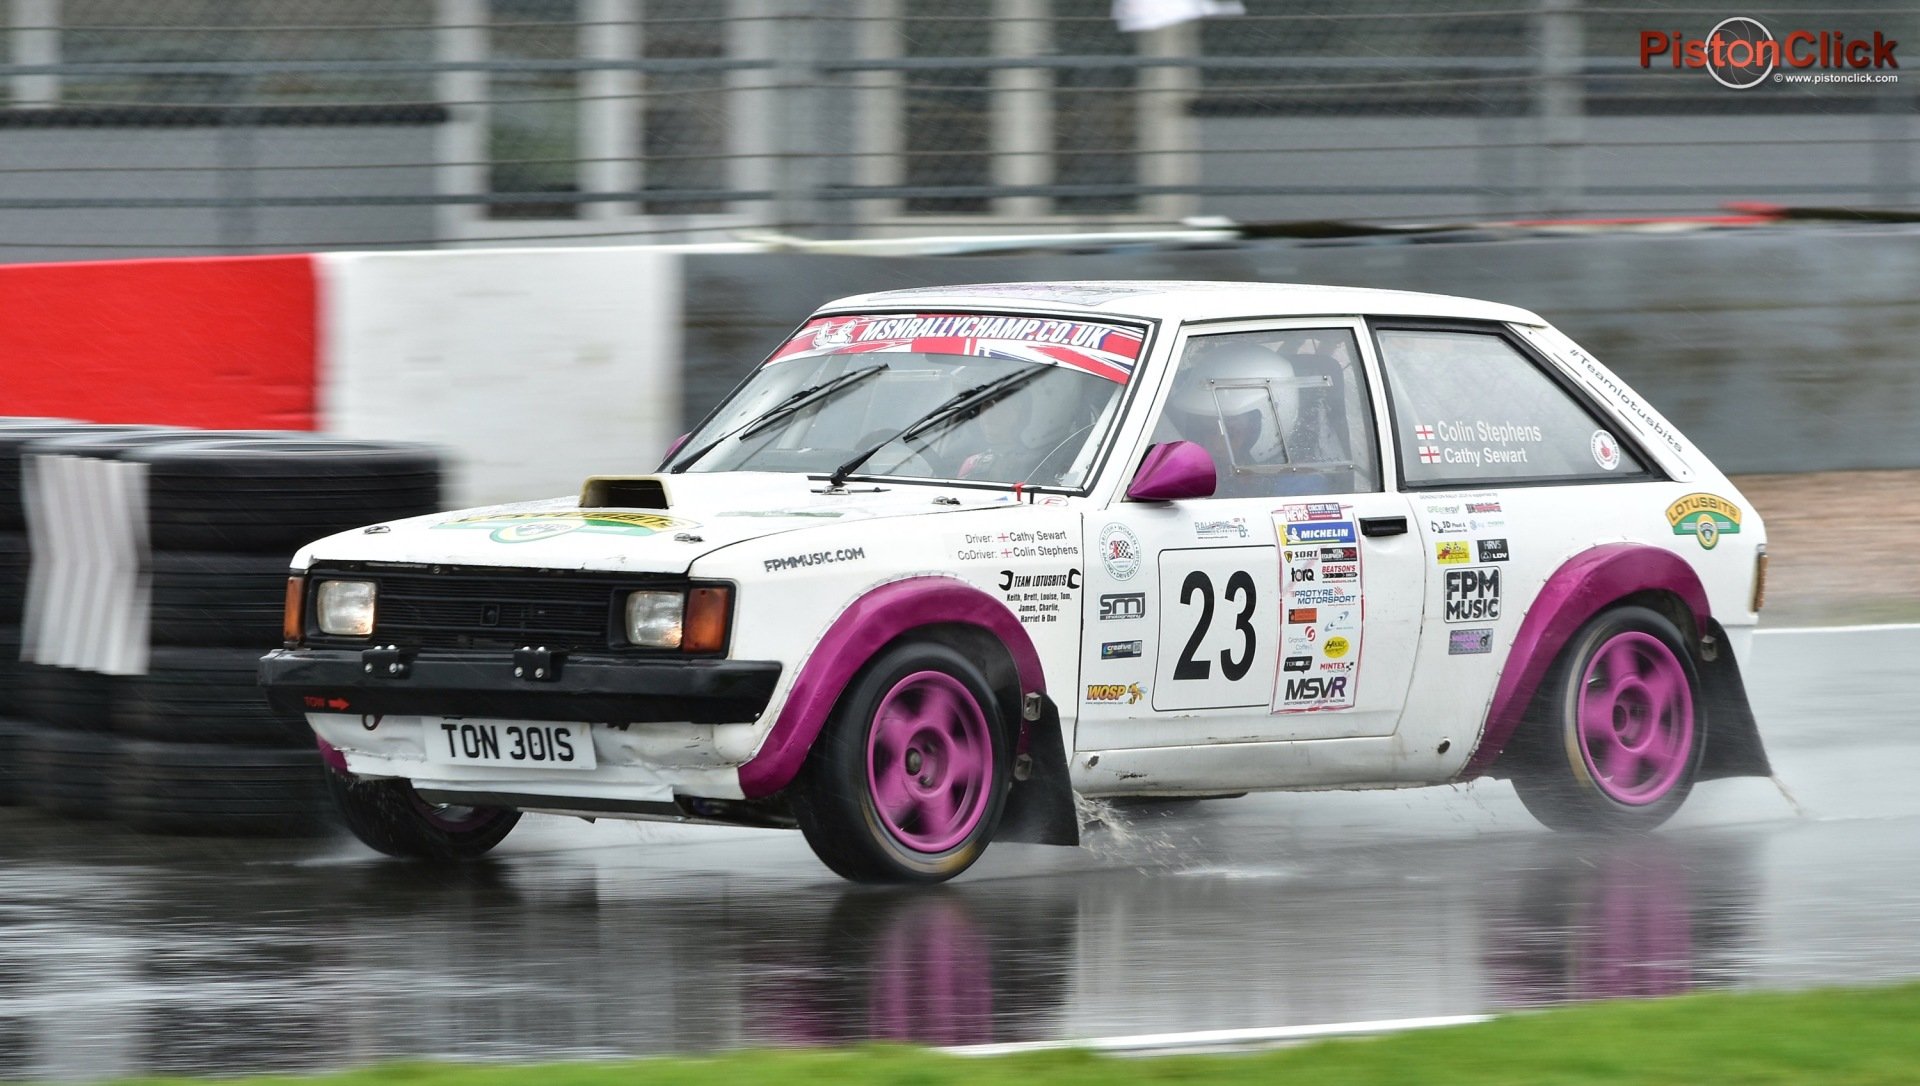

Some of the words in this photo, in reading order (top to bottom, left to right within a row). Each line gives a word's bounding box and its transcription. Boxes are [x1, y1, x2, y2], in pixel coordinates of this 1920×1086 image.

[861, 317, 1112, 349] MSNRALLYCHAMP.CO.UK
[1437, 421, 1472, 442] Colin
[1476, 422, 1542, 447] Stephens
[1444, 448, 1481, 467] Cathy
[1484, 448, 1528, 464] Sewart
[1286, 508, 1309, 521] NEWS
[1669, 497, 1737, 521] LOTUSBITS
[965, 534, 994, 544] Driver:
[1009, 531, 1035, 543] Cathy
[1036, 530, 1067, 541] Sewart
[1301, 528, 1349, 539] MICHELIN
[764, 547, 866, 573] FPMMUSIC.COM
[957, 549, 998, 560] CoDriver:
[1013, 546, 1036, 557] Colin
[1037, 545, 1079, 557] Stephens
[1322, 565, 1356, 573] BEATSON'S
[1014, 576, 1032, 587] TEAM
[1032, 574, 1067, 587] LOTUSBITS
[1446, 569, 1499, 600] FPM
[1006, 593, 1022, 602] Keith,
[1040, 592, 1059, 601] Louise,
[1060, 592, 1072, 601] Tom,
[1295, 588, 1333, 598] PROTYRE
[1297, 595, 1356, 605] MOTORSPORT
[1018, 604, 1038, 613] James,
[1039, 603, 1060, 613] Charlie,
[1446, 599, 1498, 620] MUSIC
[1020, 615, 1040, 623] Harriet
[1047, 614, 1057, 622] Dan
[1173, 570, 1257, 682] 23
[1320, 662, 1346, 671] MINTEX
[1087, 685, 1127, 701] WOSP
[1285, 676, 1347, 700] MSVR
[441, 723, 500, 760] TON
[506, 726, 574, 762] 301S
